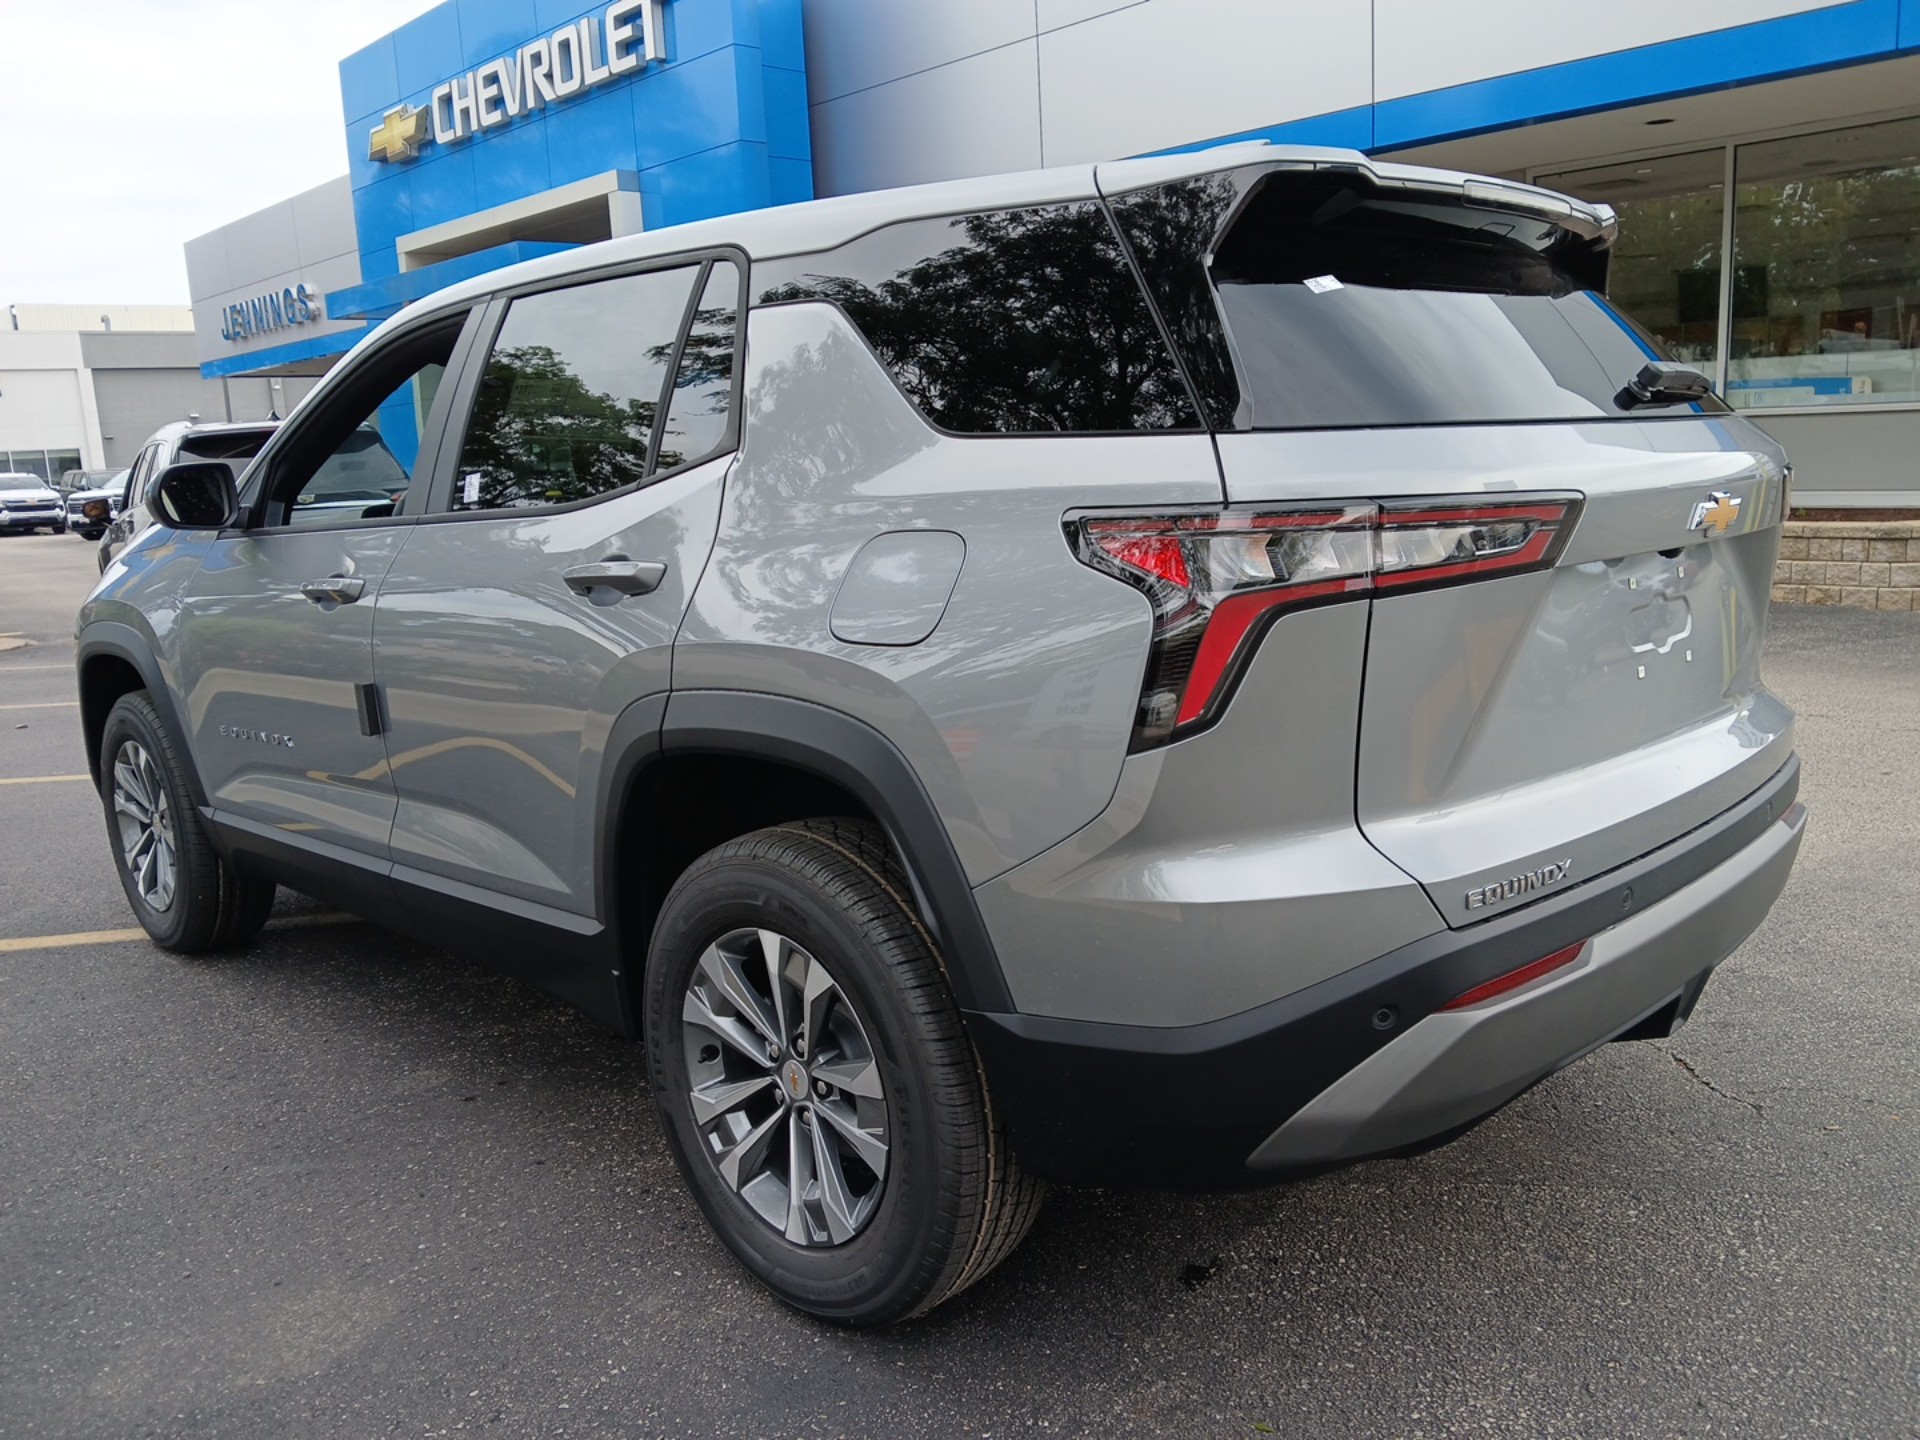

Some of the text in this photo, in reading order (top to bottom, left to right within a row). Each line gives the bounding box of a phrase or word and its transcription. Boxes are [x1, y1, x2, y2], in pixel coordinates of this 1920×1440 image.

[431, 0, 667, 145] CHEVROLET
[221, 283, 317, 341] JENNINGS
[219, 725, 294, 748] EQUINOX
[1465, 858, 1572, 910] EQUINOX
